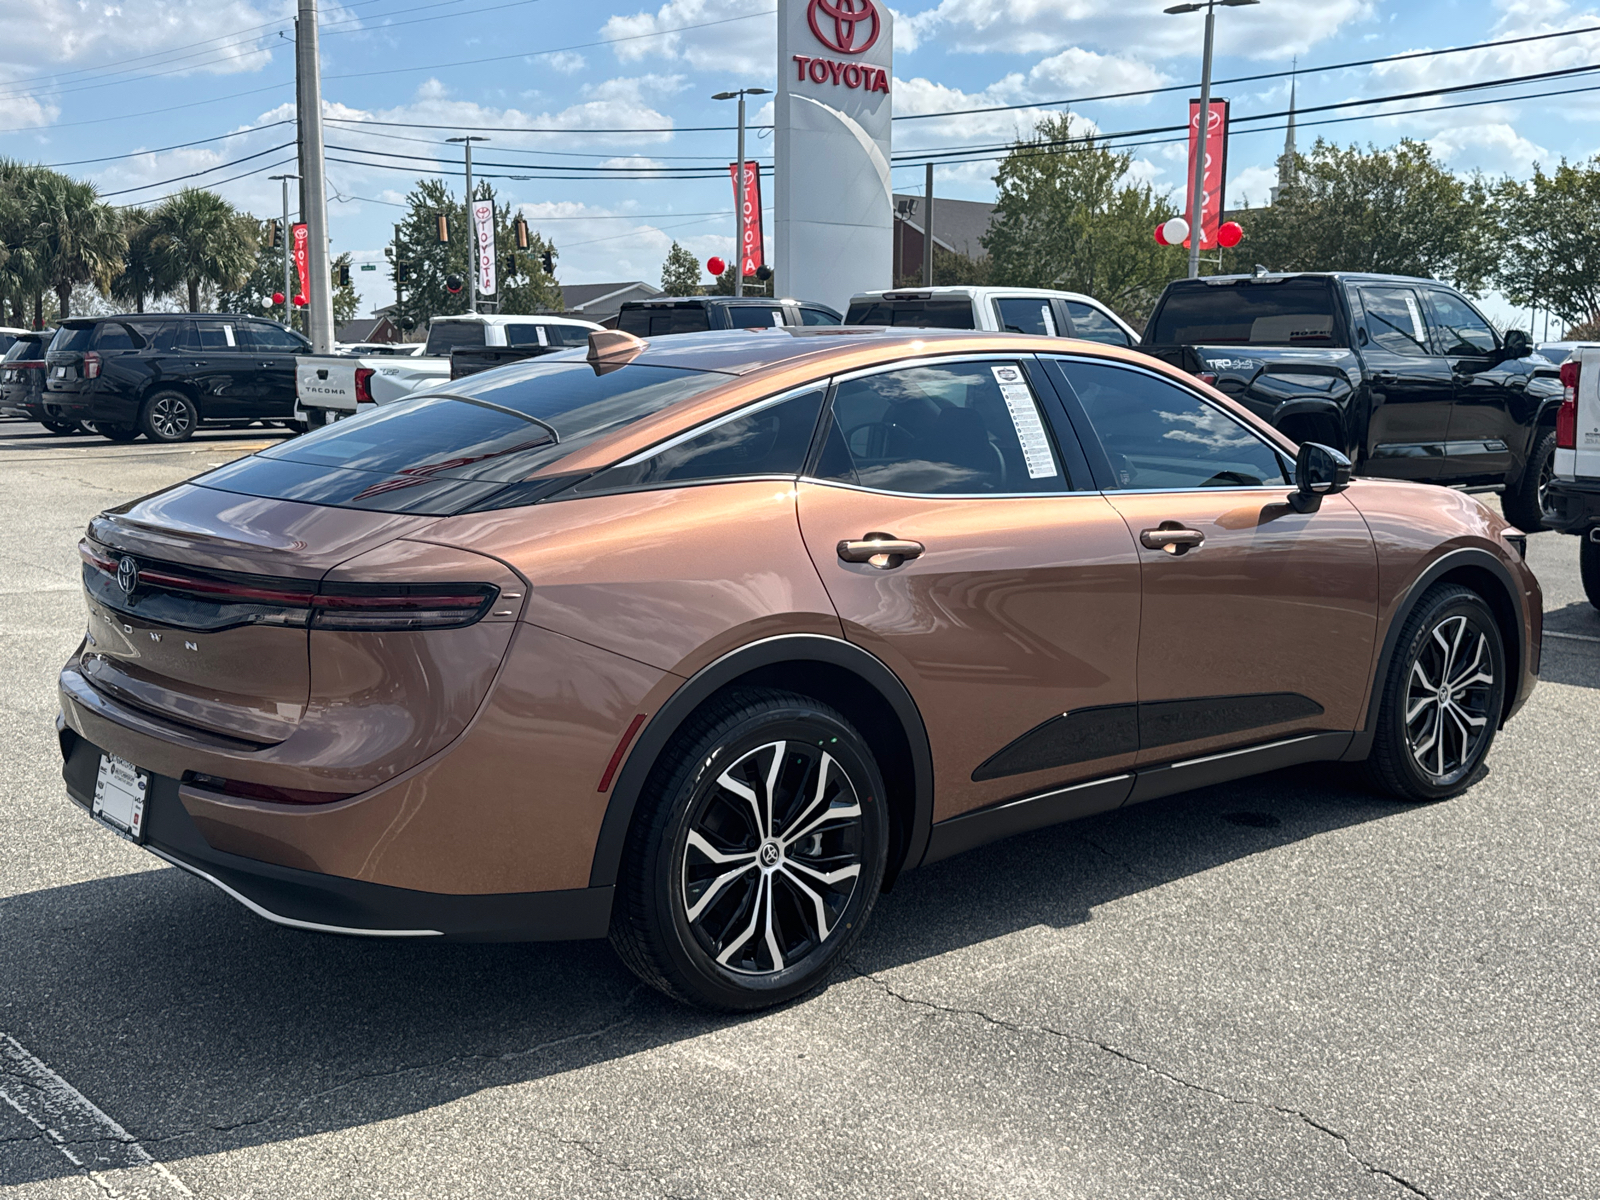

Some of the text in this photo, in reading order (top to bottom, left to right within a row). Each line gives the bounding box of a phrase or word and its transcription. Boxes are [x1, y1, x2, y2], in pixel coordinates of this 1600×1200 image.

[793, 54, 890, 94] TOYOTA
[743, 187, 756, 272] TOYOTA
[298, 241, 307, 301] TOY
[480, 221, 491, 289] TOYOTA
[1206, 358, 1232, 371] TRD
[305, 386, 346, 395] TACOMA
